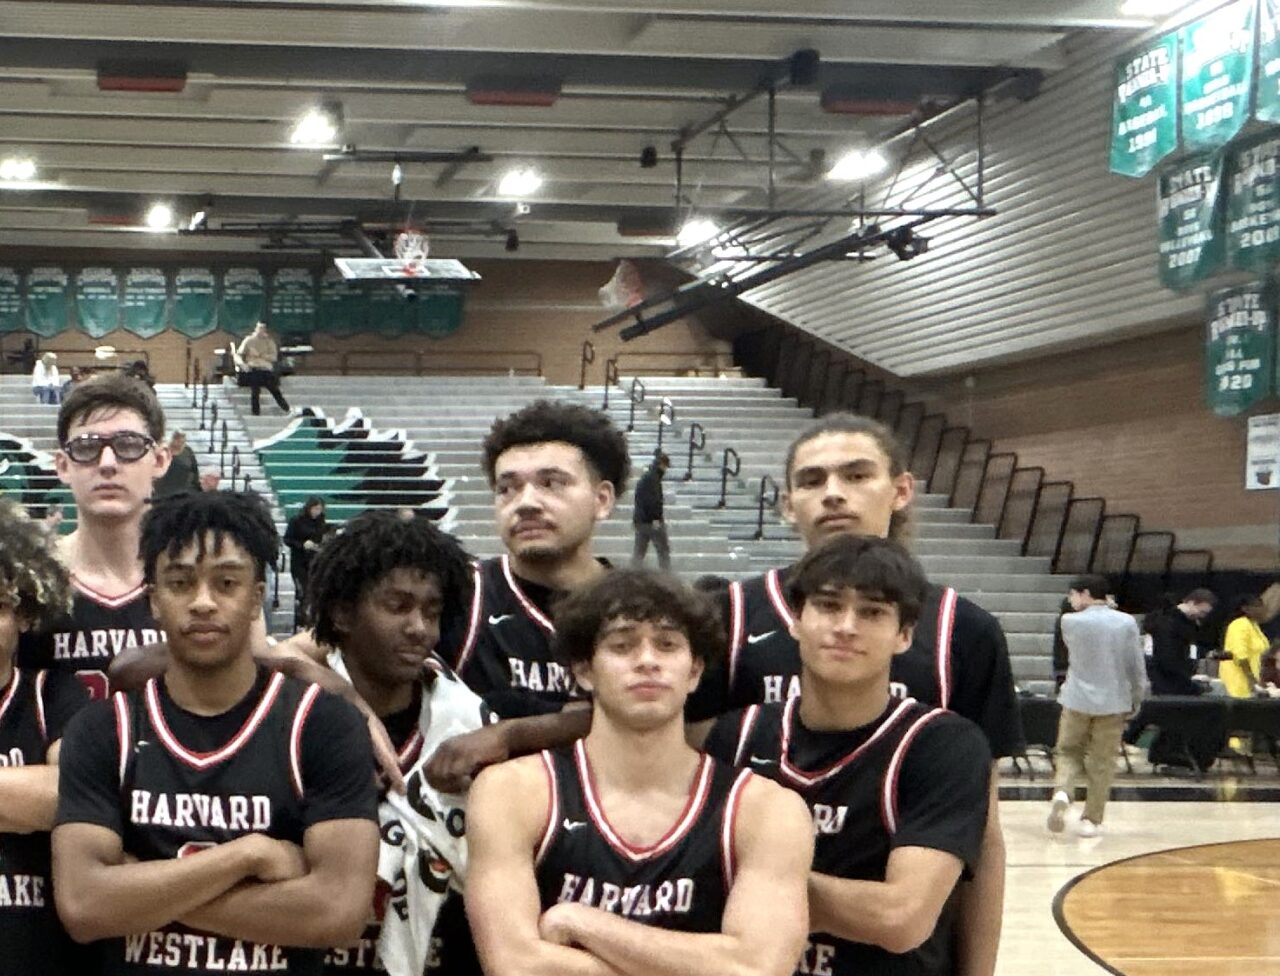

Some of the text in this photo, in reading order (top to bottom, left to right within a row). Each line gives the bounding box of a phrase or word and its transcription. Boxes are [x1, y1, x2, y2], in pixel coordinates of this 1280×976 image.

[131, 789, 271, 831] HARVARD
[557, 873, 694, 916] HARVARD
[124, 932, 287, 971] WESTLAKE
